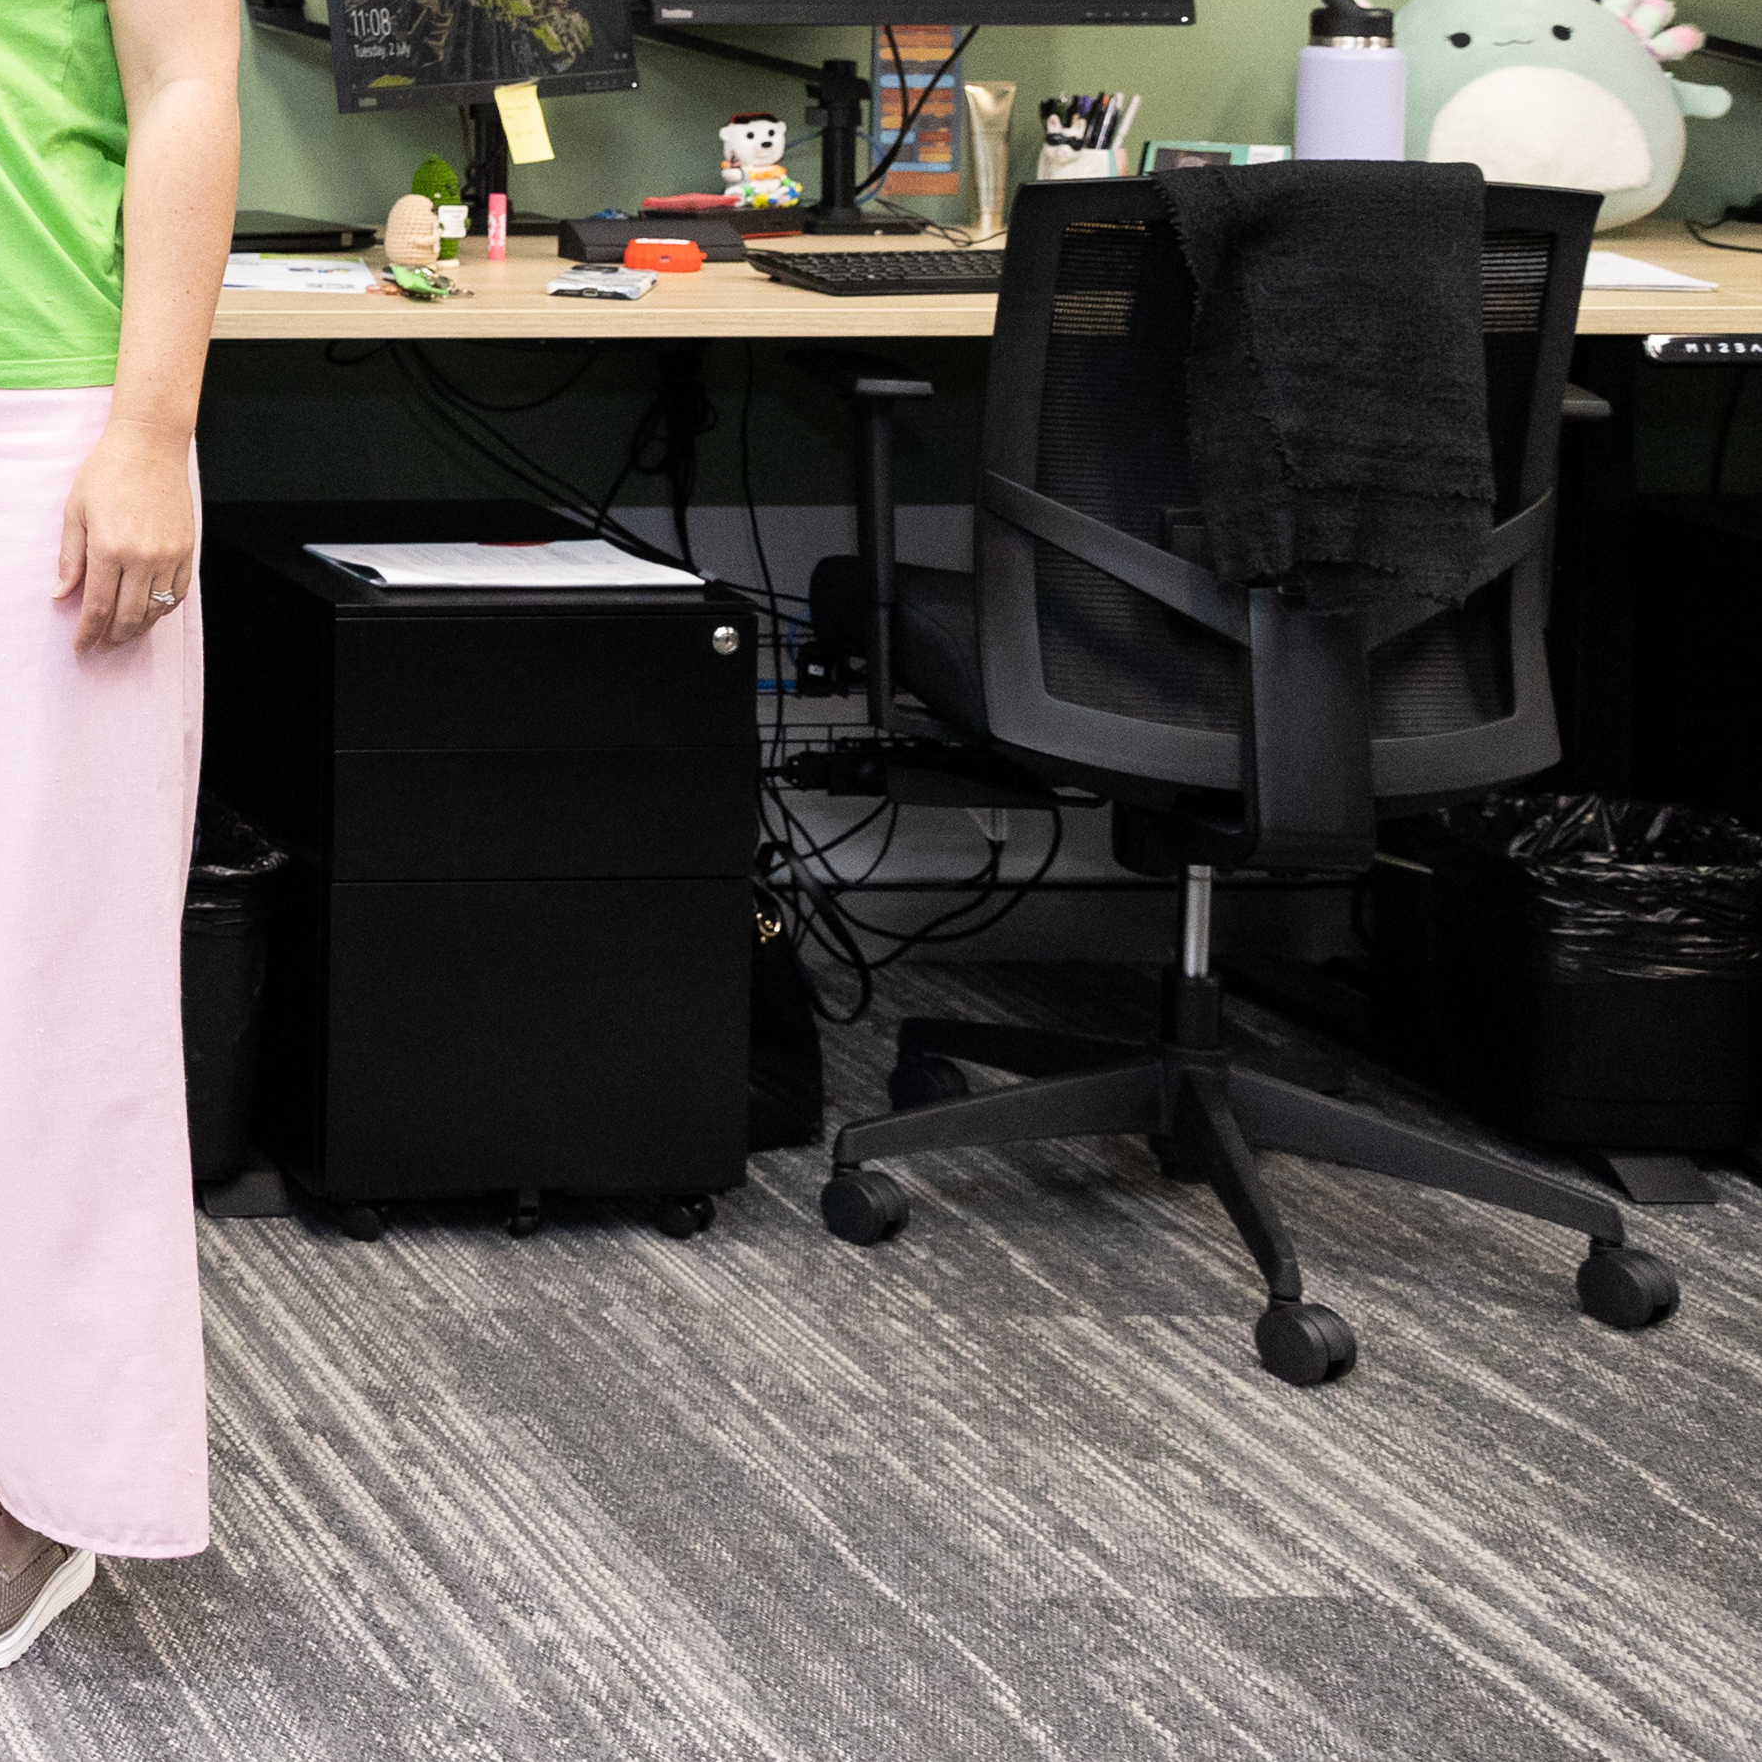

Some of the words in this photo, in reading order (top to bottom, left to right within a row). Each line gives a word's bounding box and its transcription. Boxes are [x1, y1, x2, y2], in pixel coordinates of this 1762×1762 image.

[350, 7, 392, 37] 11:08
[388, 42, 395, 56] 2
[396, 41, 412, 59] July
